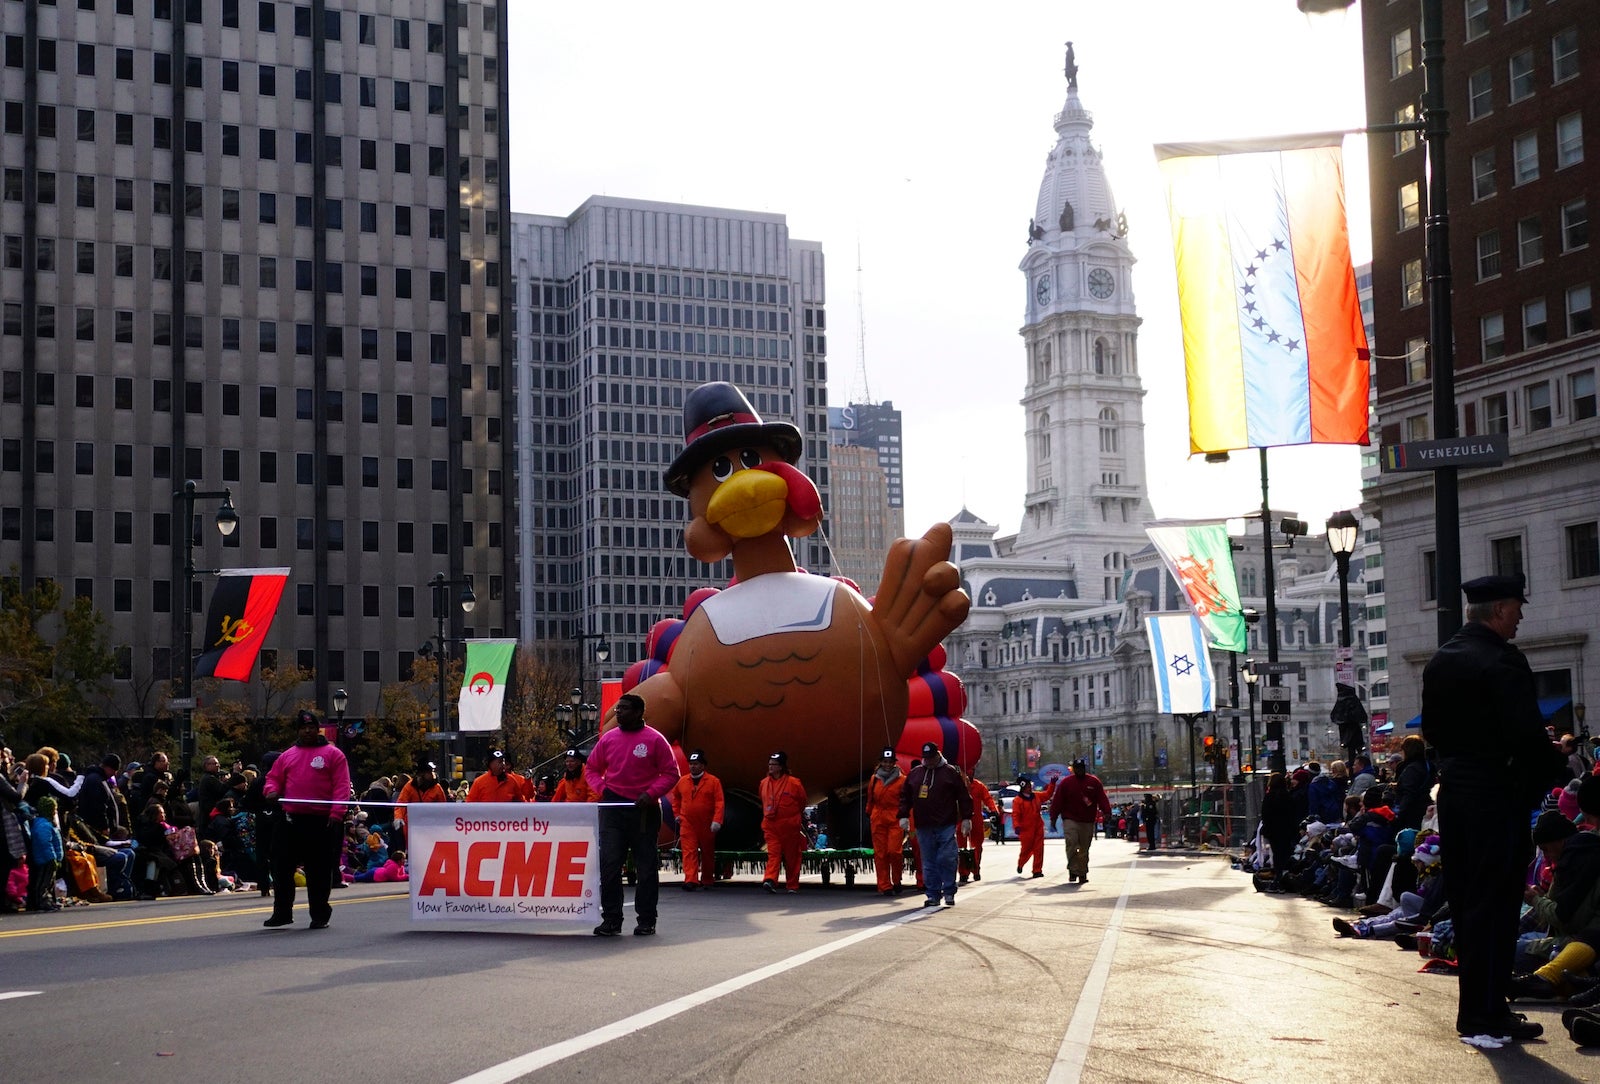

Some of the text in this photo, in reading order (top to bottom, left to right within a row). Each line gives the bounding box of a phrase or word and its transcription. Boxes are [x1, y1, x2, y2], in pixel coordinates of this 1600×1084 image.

[1419, 443, 1494, 460] VENEZUELA
[455, 817, 550, 835] Sponsored by
[417, 901, 442, 914] Your
[445, 901, 487, 914] Favorite
[488, 902, 515, 914] Local
